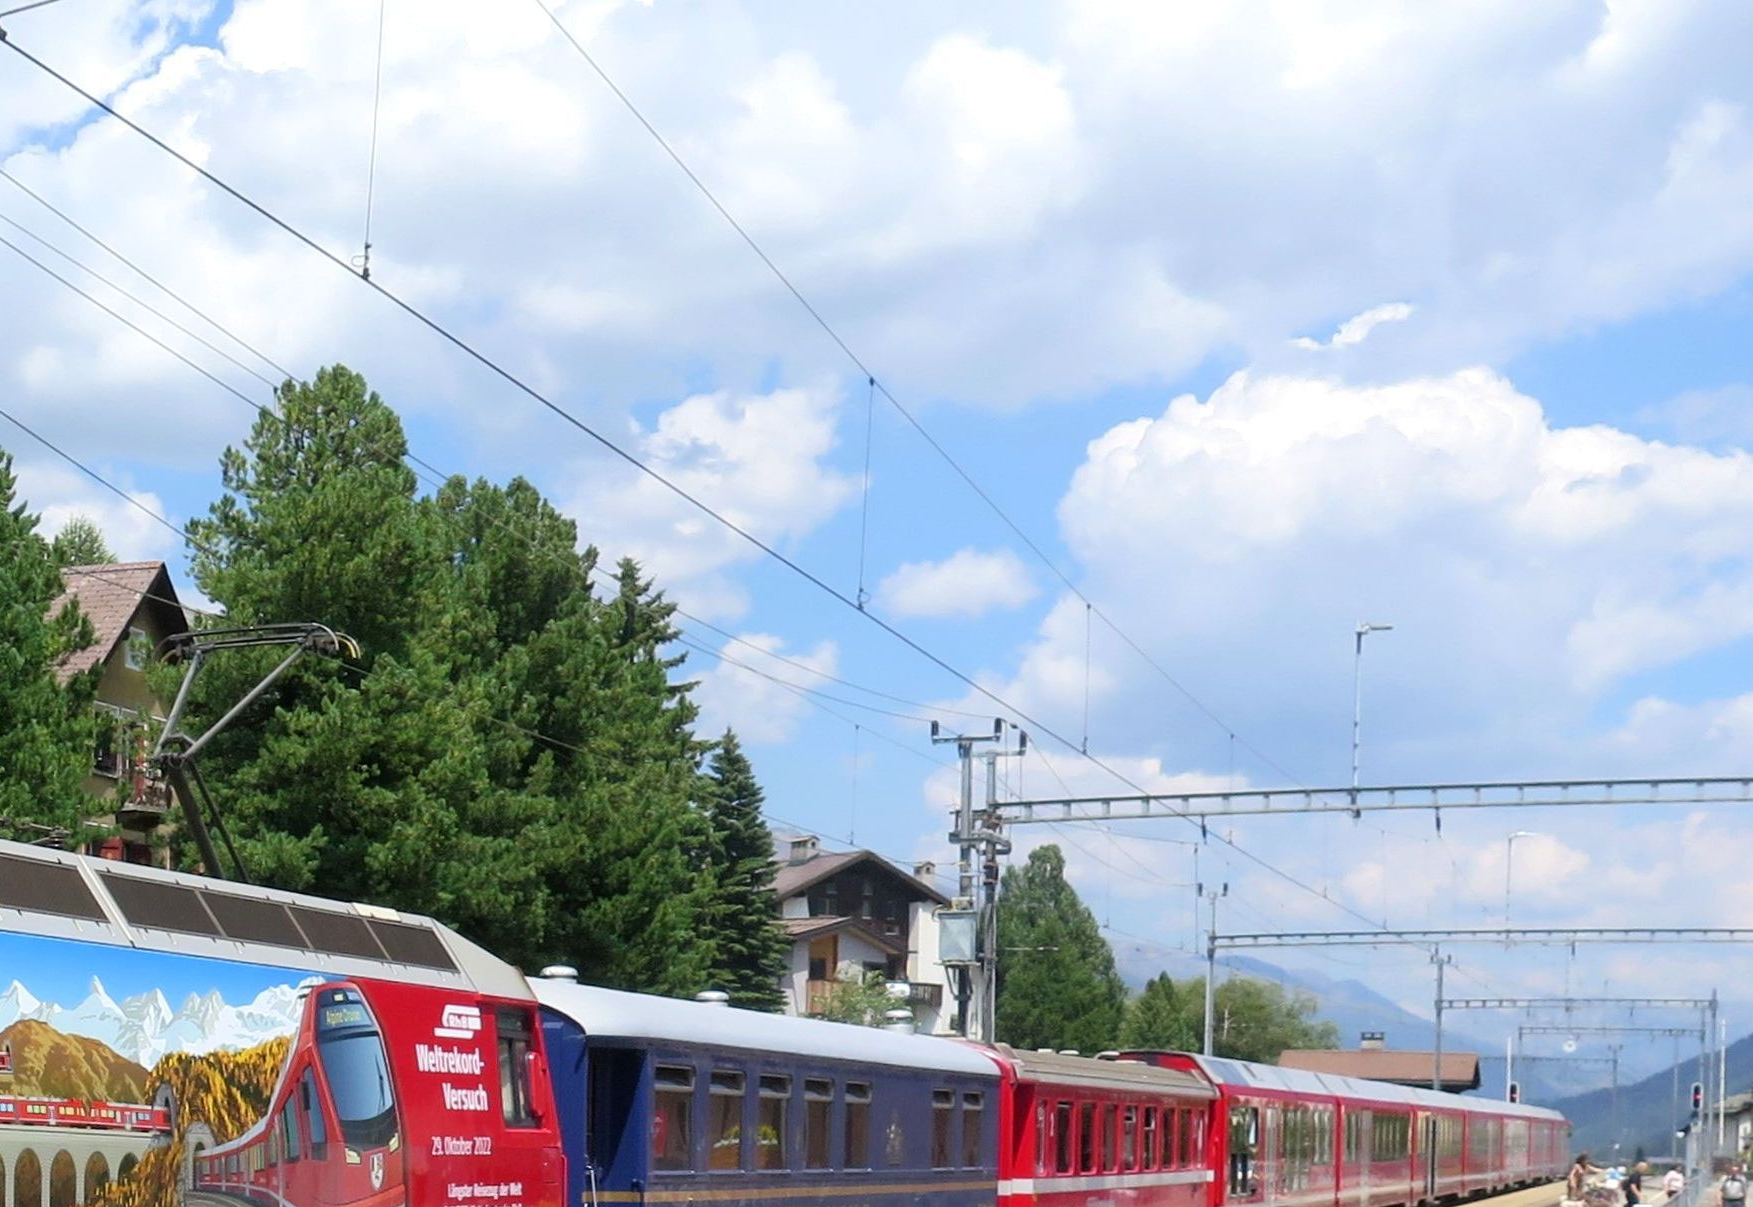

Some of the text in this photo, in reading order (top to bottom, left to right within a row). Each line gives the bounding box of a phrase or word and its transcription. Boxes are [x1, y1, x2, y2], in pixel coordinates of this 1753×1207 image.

[415, 1044, 485, 1075] Weltrekord-
[442, 1082, 488, 1111] Versuch
[444, 1136, 473, 1155] Oktober
[473, 1136, 492, 1155] 2022
